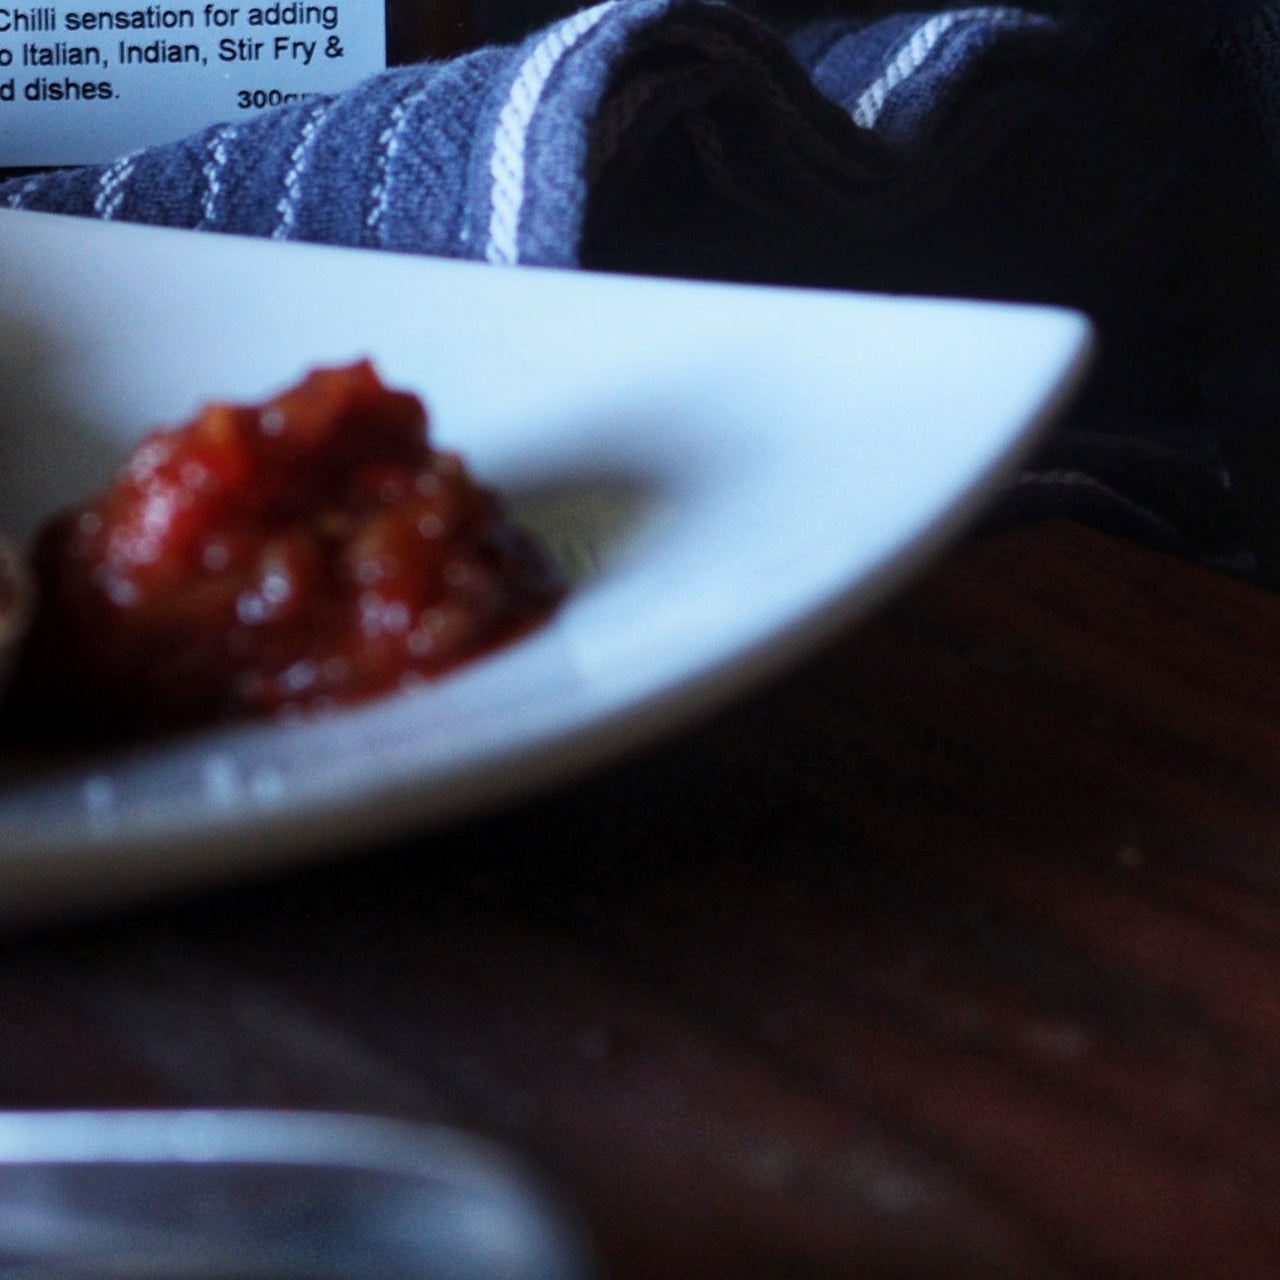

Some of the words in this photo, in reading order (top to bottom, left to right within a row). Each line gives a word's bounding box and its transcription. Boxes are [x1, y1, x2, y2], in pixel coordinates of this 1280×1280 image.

[65, 4, 194, 31] sensation
[204, 4, 239, 27] for
[248, 3, 338, 30] adding
[22, 43, 108, 68] Italian,
[119, 41, 208, 65] Indian,
[218, 38, 263, 62] Stir
[273, 37, 316, 66] Fry
[324, 36, 344, 58] &
[24, 77, 121, 101] dishes.
